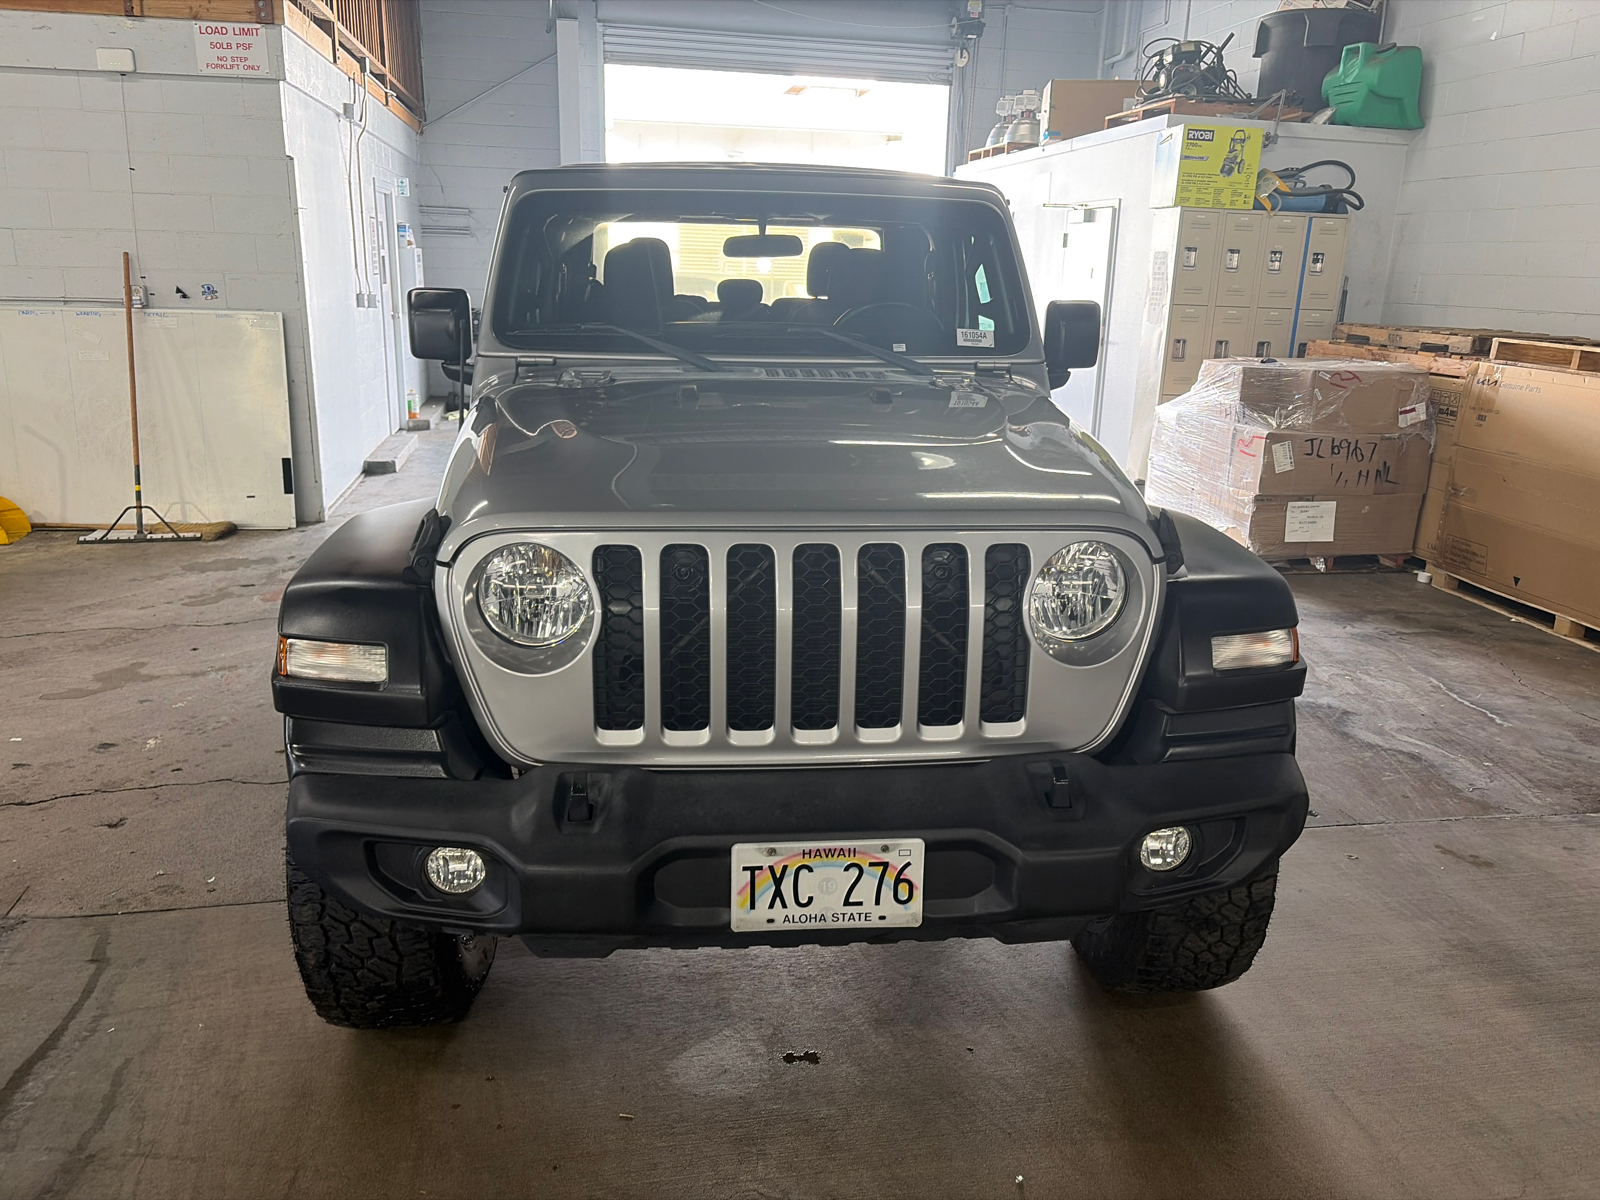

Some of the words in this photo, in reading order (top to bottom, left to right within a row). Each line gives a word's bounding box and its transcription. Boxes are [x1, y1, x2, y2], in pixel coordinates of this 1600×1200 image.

[198, 25, 228, 36] LOAD
[232, 27, 260, 36] LIMIT
[209, 41, 233, 50] 50LB
[235, 42, 254, 51] PSF
[1187, 130, 1214, 140] RYOBI
[960, 331, 988, 340] 161054A
[1499, 380, 1525, 392] Genuine
[1524, 384, 1542, 394] Parts
[802, 847, 857, 860] HAWAII
[742, 864, 814, 911] TXC
[842, 861, 914, 907] 276
[782, 913, 827, 925] ALOHA
[831, 912, 873, 923] STATE
